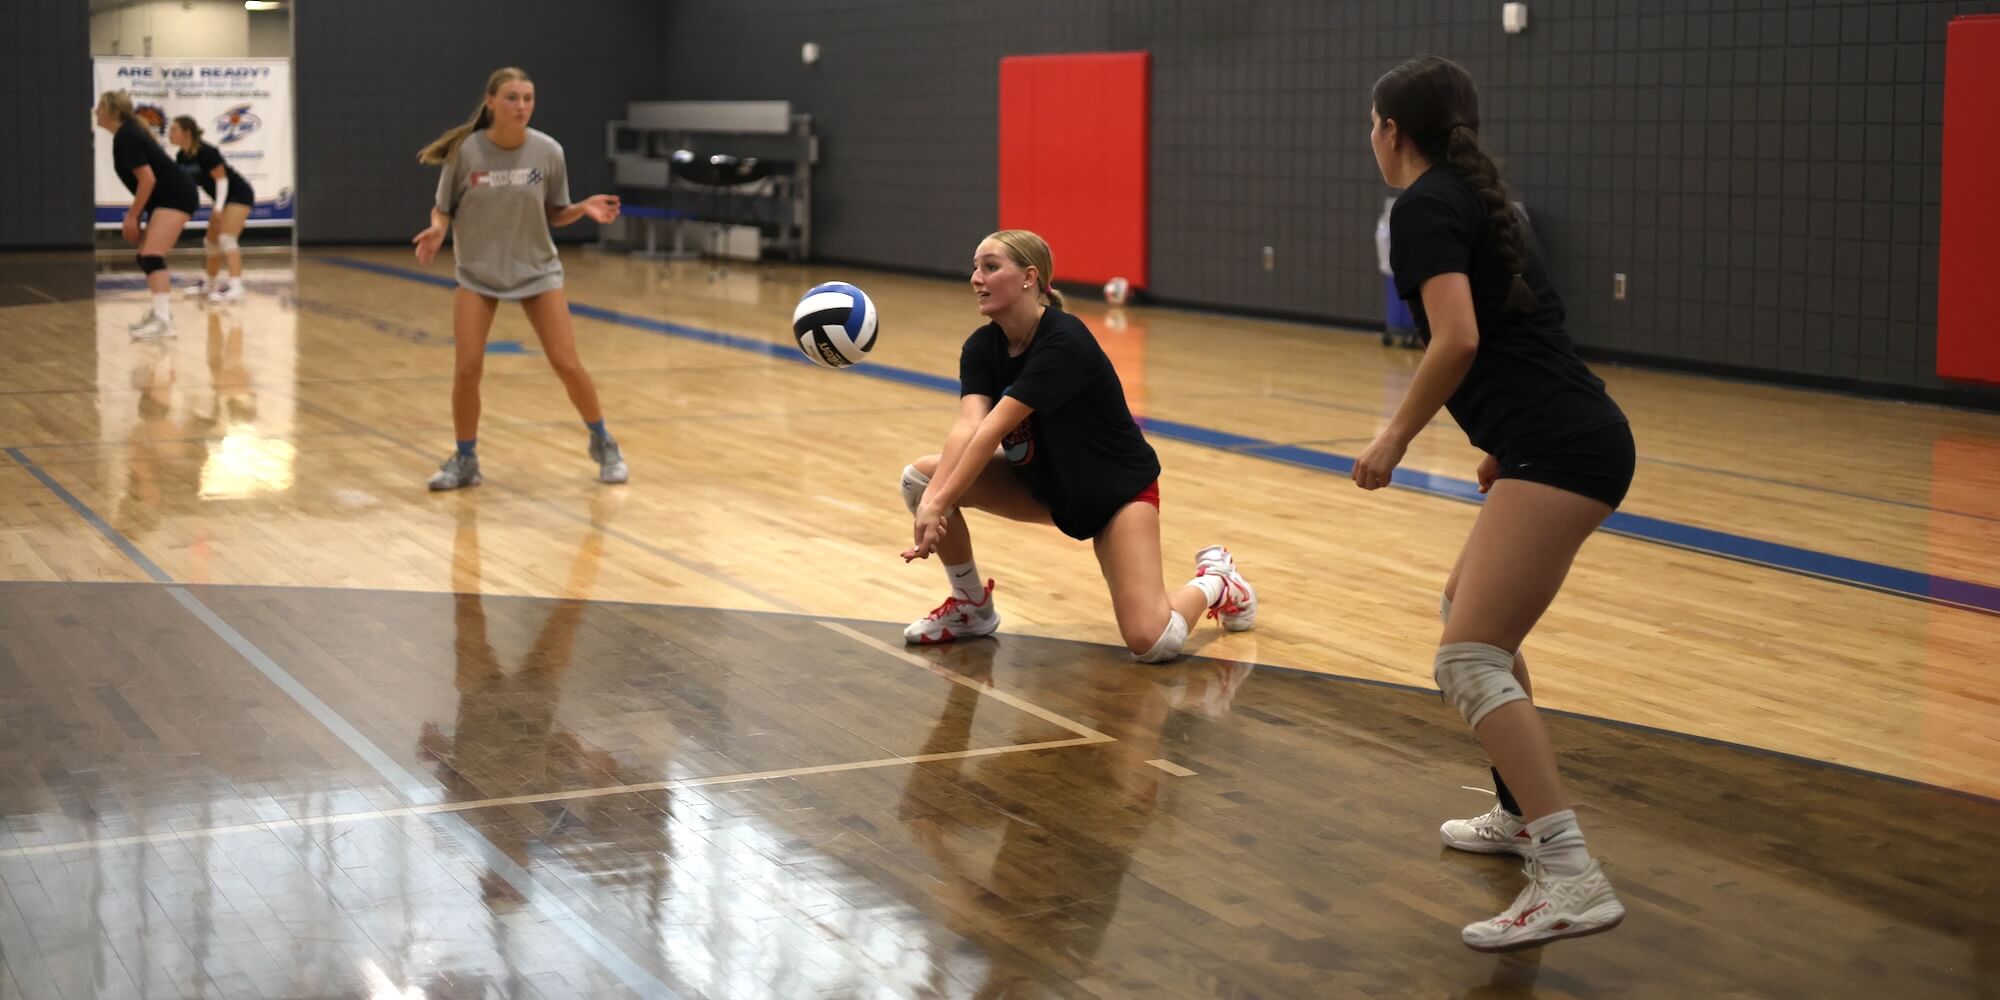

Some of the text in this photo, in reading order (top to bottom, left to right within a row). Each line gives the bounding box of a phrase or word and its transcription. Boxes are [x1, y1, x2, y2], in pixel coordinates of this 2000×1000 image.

[117, 66, 270, 78] ARE YOU READY?
[120, 88, 169, 98] nnual
